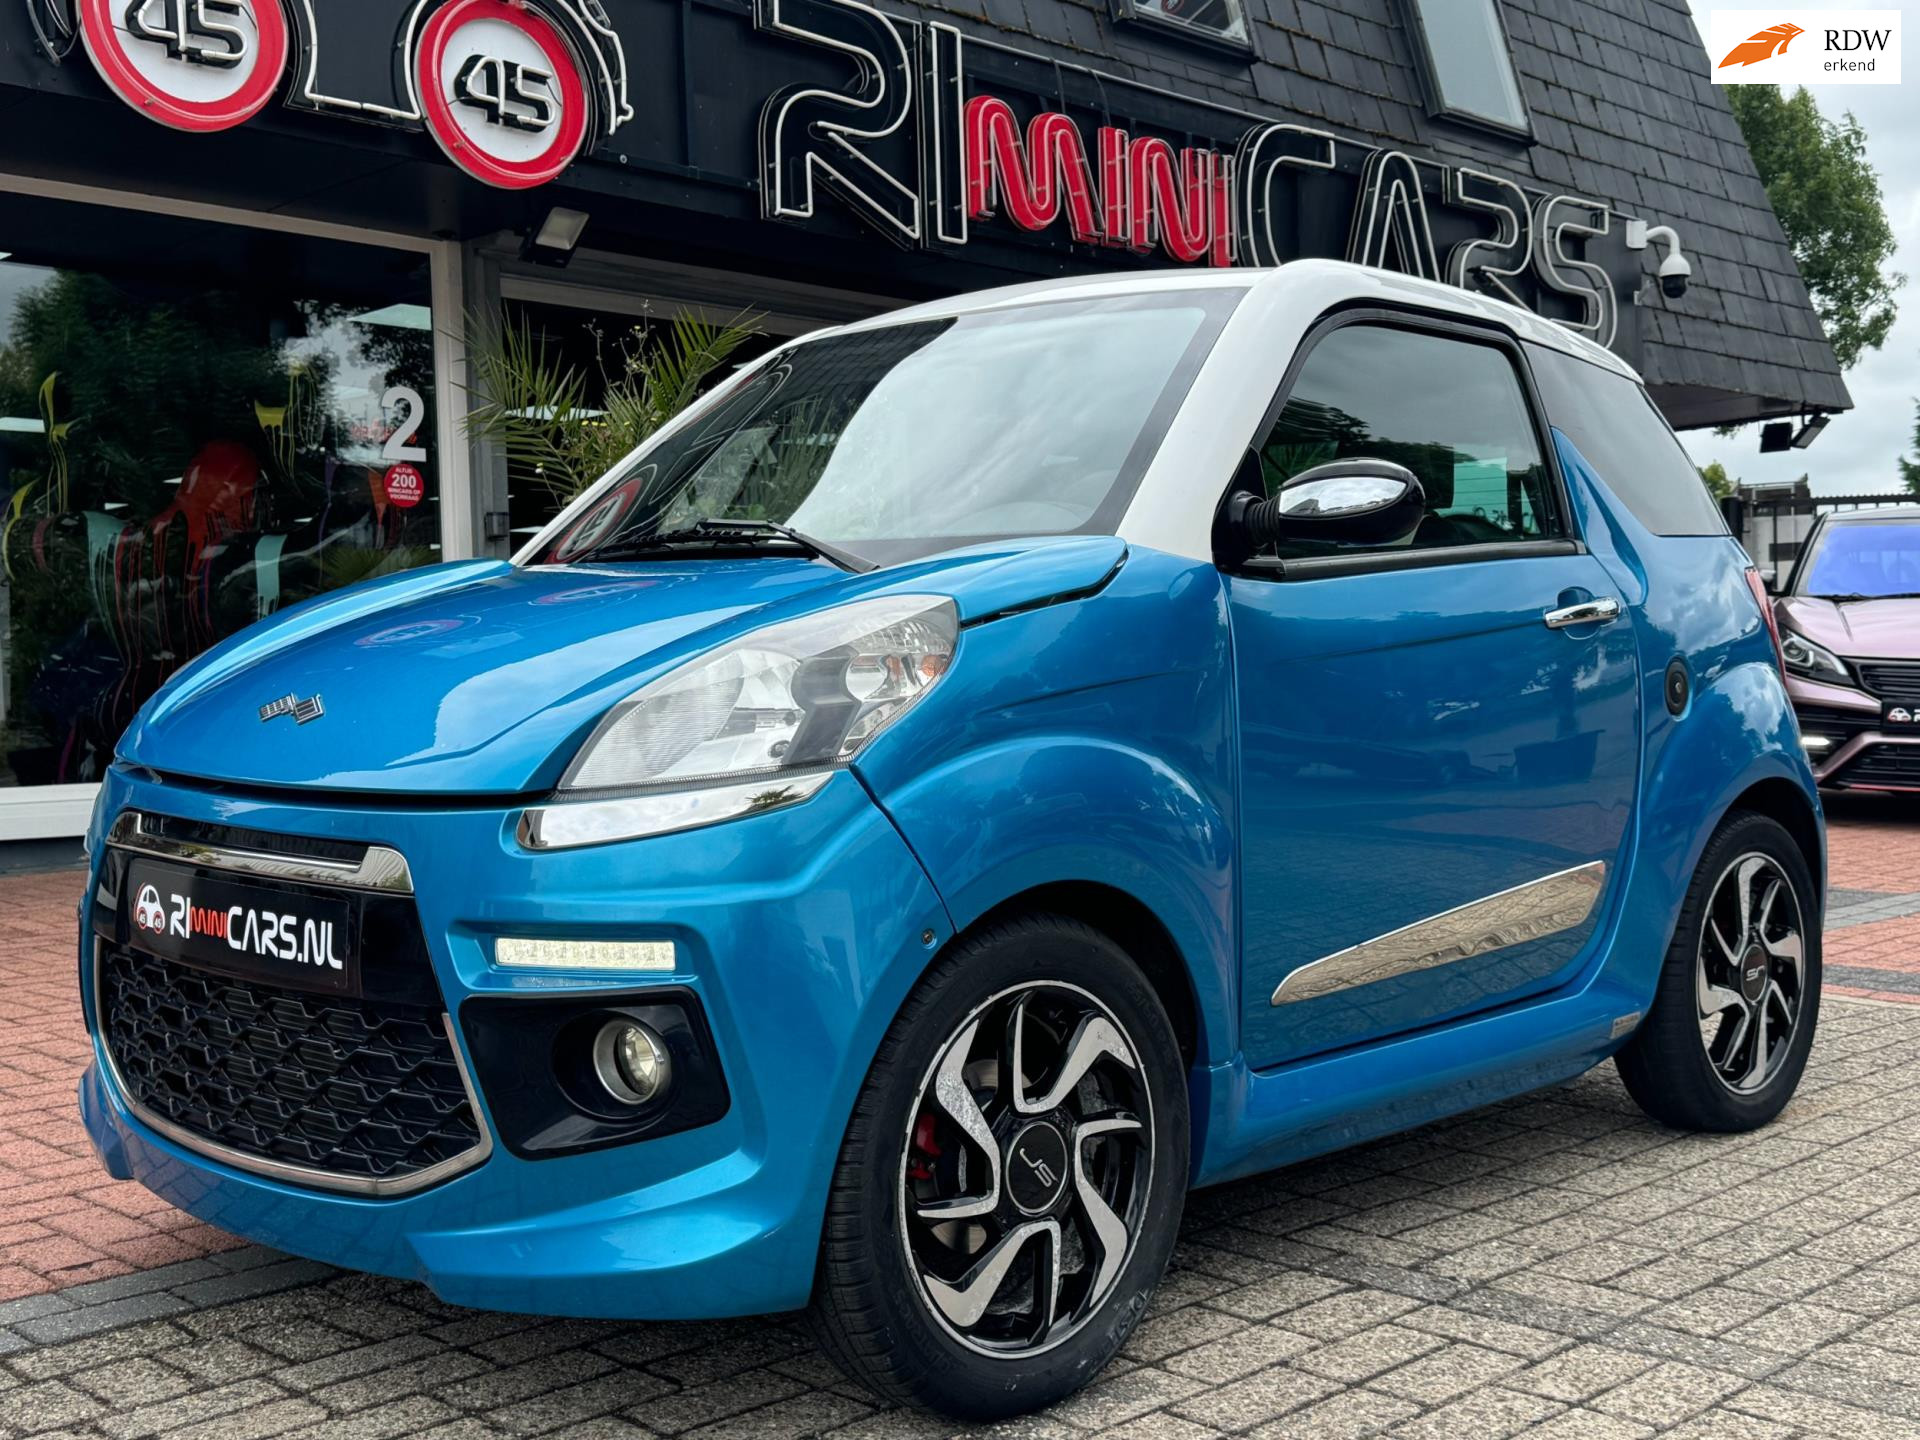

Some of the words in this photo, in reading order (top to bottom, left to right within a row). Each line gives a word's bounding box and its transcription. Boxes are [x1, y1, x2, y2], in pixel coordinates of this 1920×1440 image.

[125, 0, 248, 69] 45
[454, 54, 556, 133] 45
[381, 384, 427, 462] 2
[391, 473, 417, 489] 200
